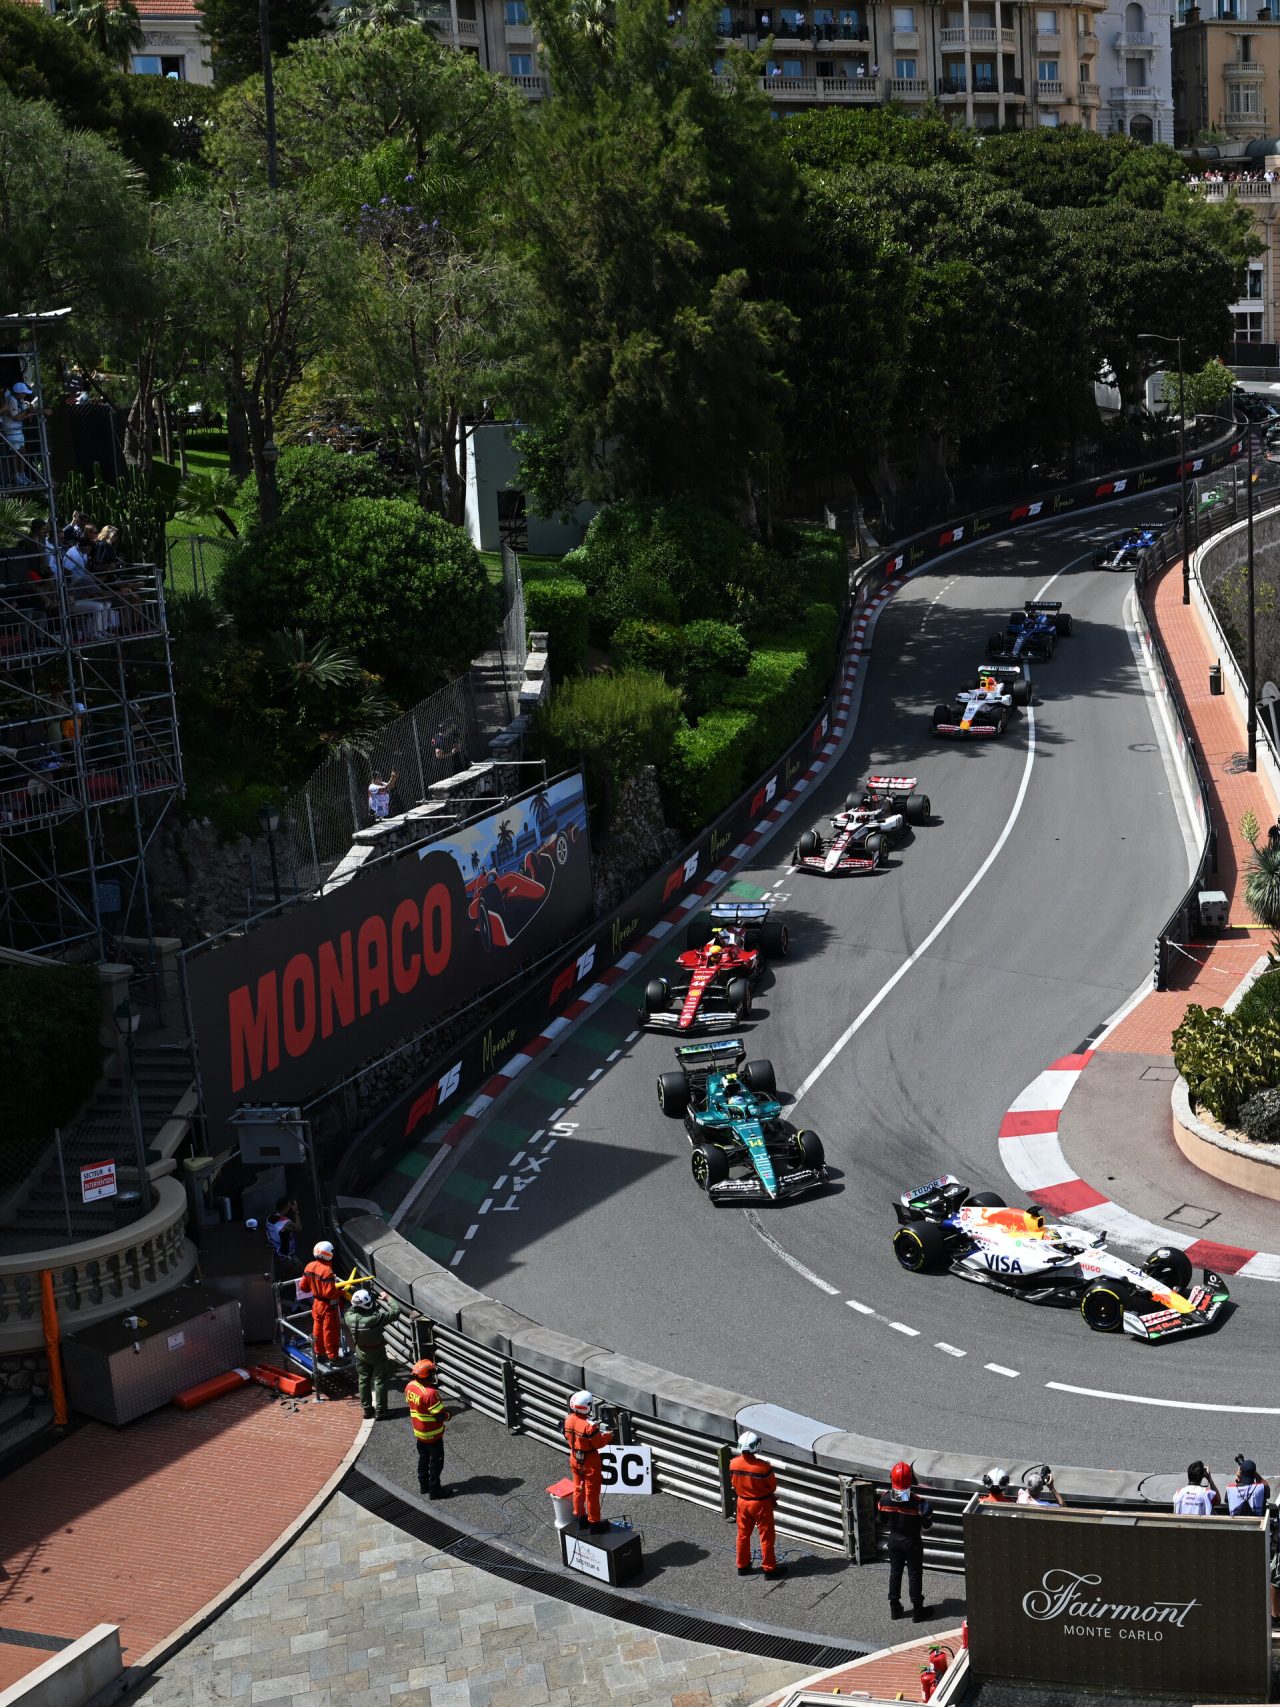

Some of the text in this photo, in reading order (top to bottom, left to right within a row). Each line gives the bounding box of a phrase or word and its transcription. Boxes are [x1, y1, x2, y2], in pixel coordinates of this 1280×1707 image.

[229, 883, 452, 1093] MONACO
[748, 1138, 762, 1148] 14
[84, 1169, 103, 1180] SECTEUR
[912, 1181, 939, 1198] TUDOR
[984, 1252, 1023, 1274] VISA
[1080, 1263, 1101, 1274] HUGO
[600, 1452, 644, 1487] SC
[1022, 1568, 1203, 1628] Fairmont
[1063, 1624, 1163, 1641] MONTE CARLO
